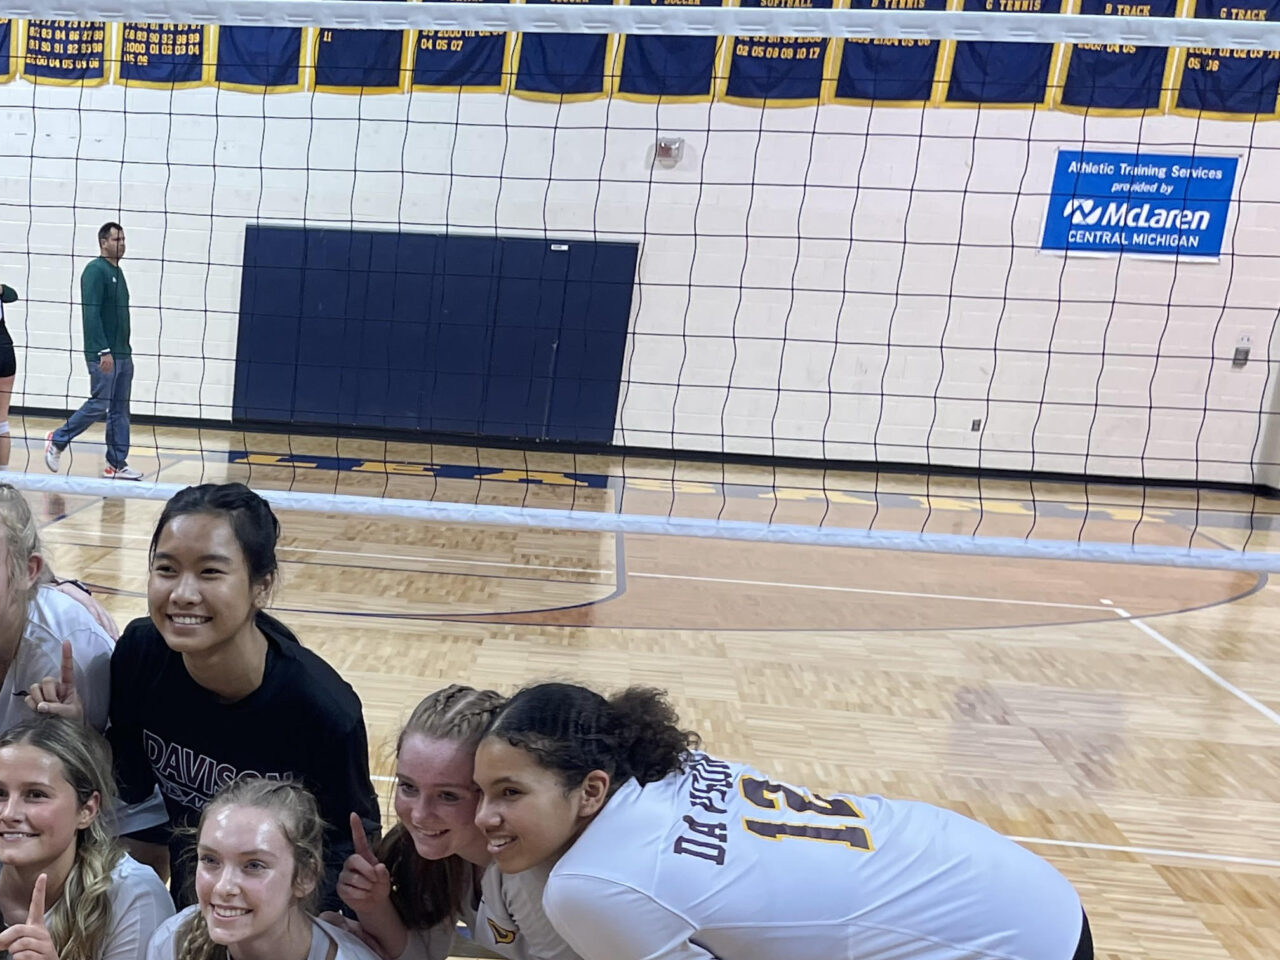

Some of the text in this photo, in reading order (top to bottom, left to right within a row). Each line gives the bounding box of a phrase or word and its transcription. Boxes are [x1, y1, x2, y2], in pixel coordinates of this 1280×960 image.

[885, 0, 926, 9] TENNIS
[1000, 0, 1041, 11] TENNIS
[1117, 5, 1151, 17] TRACK
[1220, 7, 1267, 21] G TRACK
[162, 34, 173, 44] 92
[188, 33, 200, 44] 99
[323, 31, 332, 42] 11
[54, 44, 64, 54] 91
[67, 44, 79, 54] 92
[81, 44, 92, 54] 93
[150, 45, 159, 55] 01
[162, 44, 173, 55] 02
[175, 45, 186, 56] 03
[188, 45, 200, 55] 04
[421, 38, 463, 51] 04 05 07
[737, 45, 749, 56] 02
[752, 47, 764, 58] 05
[796, 48, 806, 59] 10
[809, 48, 820, 59] 17
[49, 58, 60, 68] 04
[62, 59, 74, 69] 05
[1188, 57, 1201, 69] 05
[1068, 161, 1223, 180] Athletic Training Services
[1111, 182, 1174, 196] provided by
[1102, 202, 1211, 231] McLaren
[1068, 230, 1200, 248] CENTRAL MICHIGAN
[143, 728, 295, 795] DAVIS
[739, 774, 876, 853] 12
